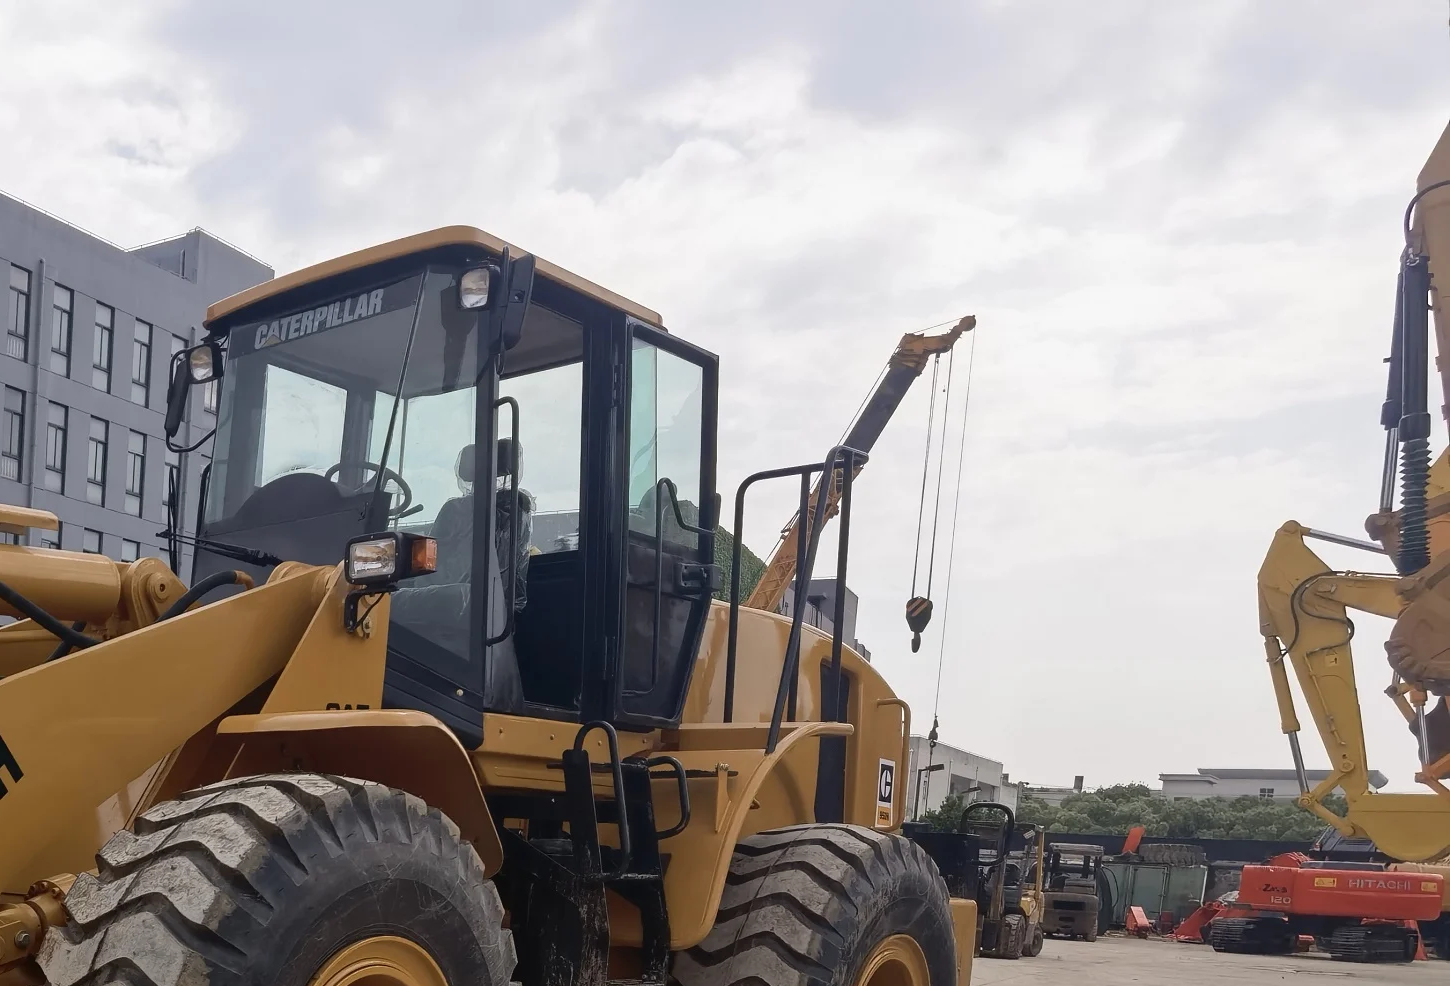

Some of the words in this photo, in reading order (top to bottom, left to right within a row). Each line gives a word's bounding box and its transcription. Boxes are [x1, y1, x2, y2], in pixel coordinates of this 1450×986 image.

[254, 288, 384, 350] CATERPILLAR
[1348, 879, 1411, 891] HITACHI
[1270, 895, 1292, 904] 120
